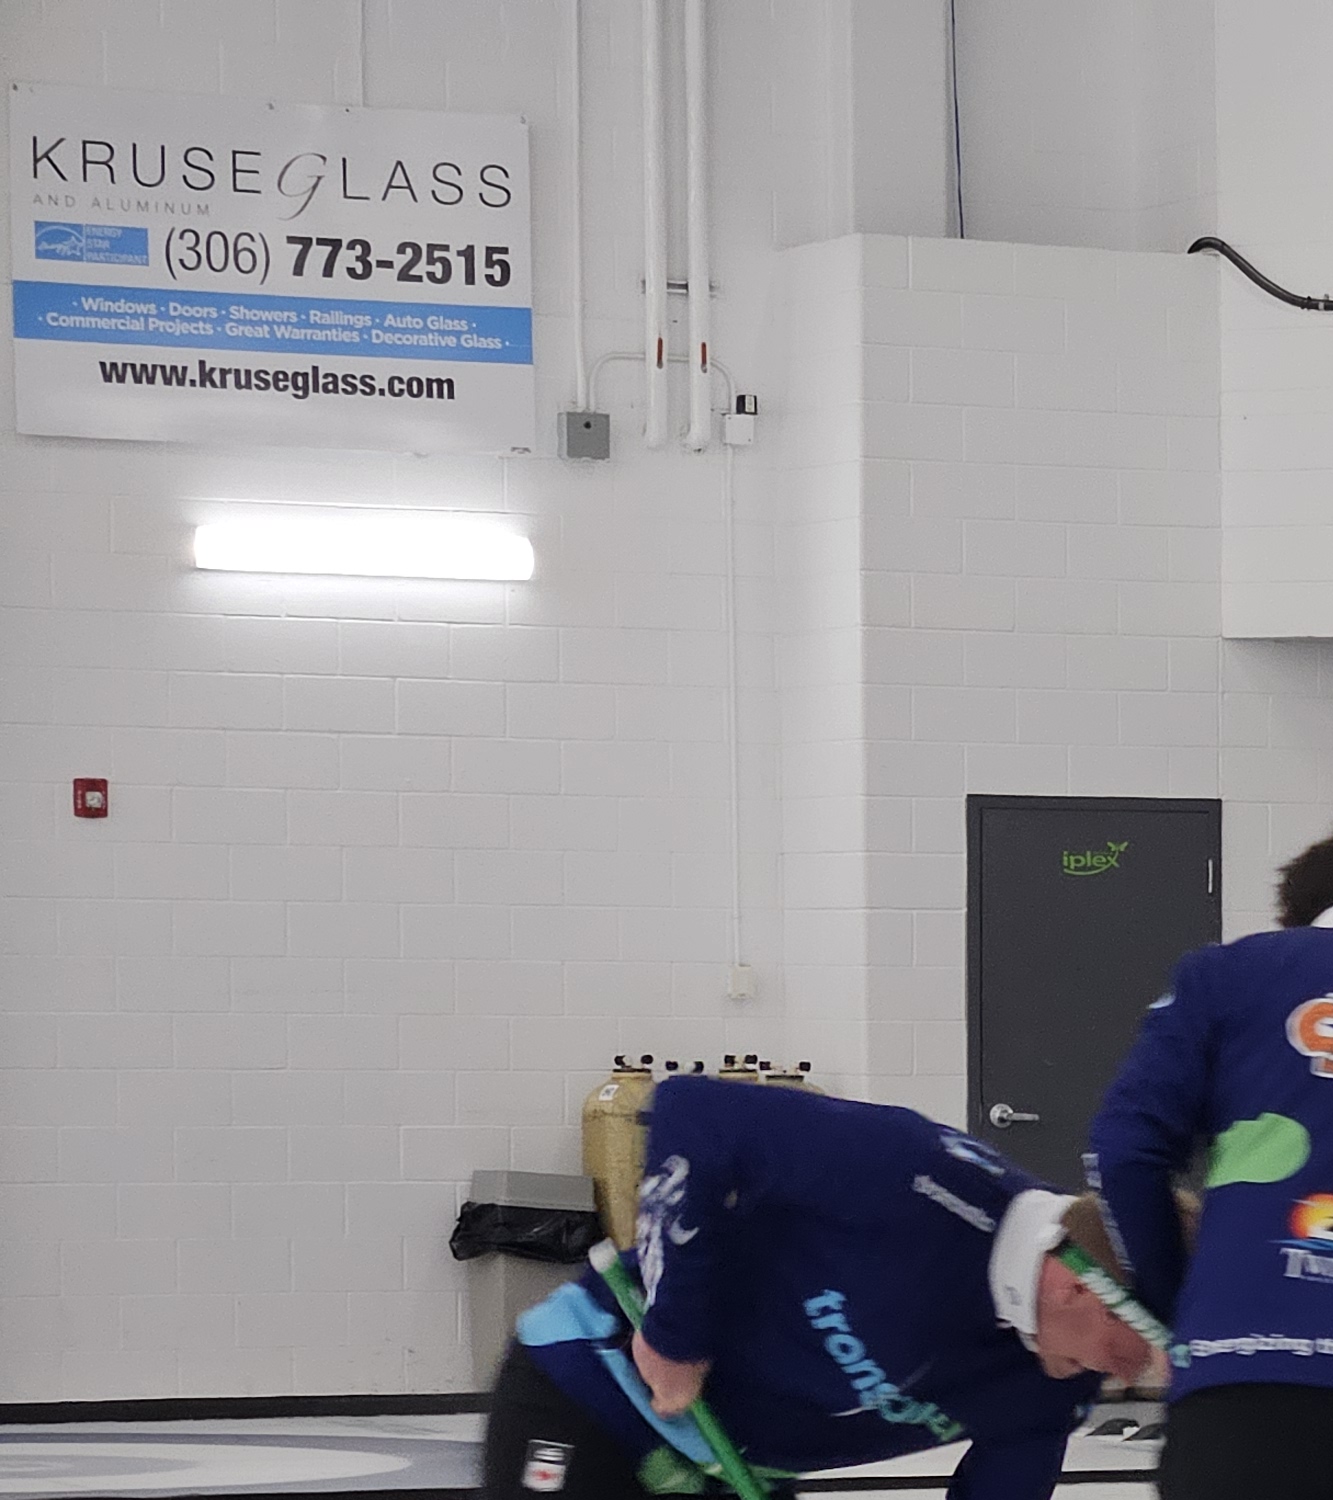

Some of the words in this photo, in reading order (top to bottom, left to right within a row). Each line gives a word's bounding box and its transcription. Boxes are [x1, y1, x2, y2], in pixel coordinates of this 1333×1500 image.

[33, 193, 76, 208] AND
[91, 197, 211, 217] ALUMINUM
[164, 226, 272, 285] (306)
[286, 235, 511, 287] 773-2515
[46, 312, 144, 331] Commercial
[149, 317, 213, 336] Projects
[225, 322, 269, 338] Great
[274, 325, 360, 343] Warranties
[371, 329, 457, 347] Decorative
[460, 334, 502, 350] Glass
[81, 297, 156, 315] Windows
[169, 302, 218, 319] Doors
[229, 305, 297, 323] Showers
[309, 310, 372, 328] Railings
[384, 314, 424, 328] Auto
[426, 316, 468, 331] Glass
[98, 359, 456, 400] www.kruseglass.com
[1062, 846, 1122, 873] iplex
